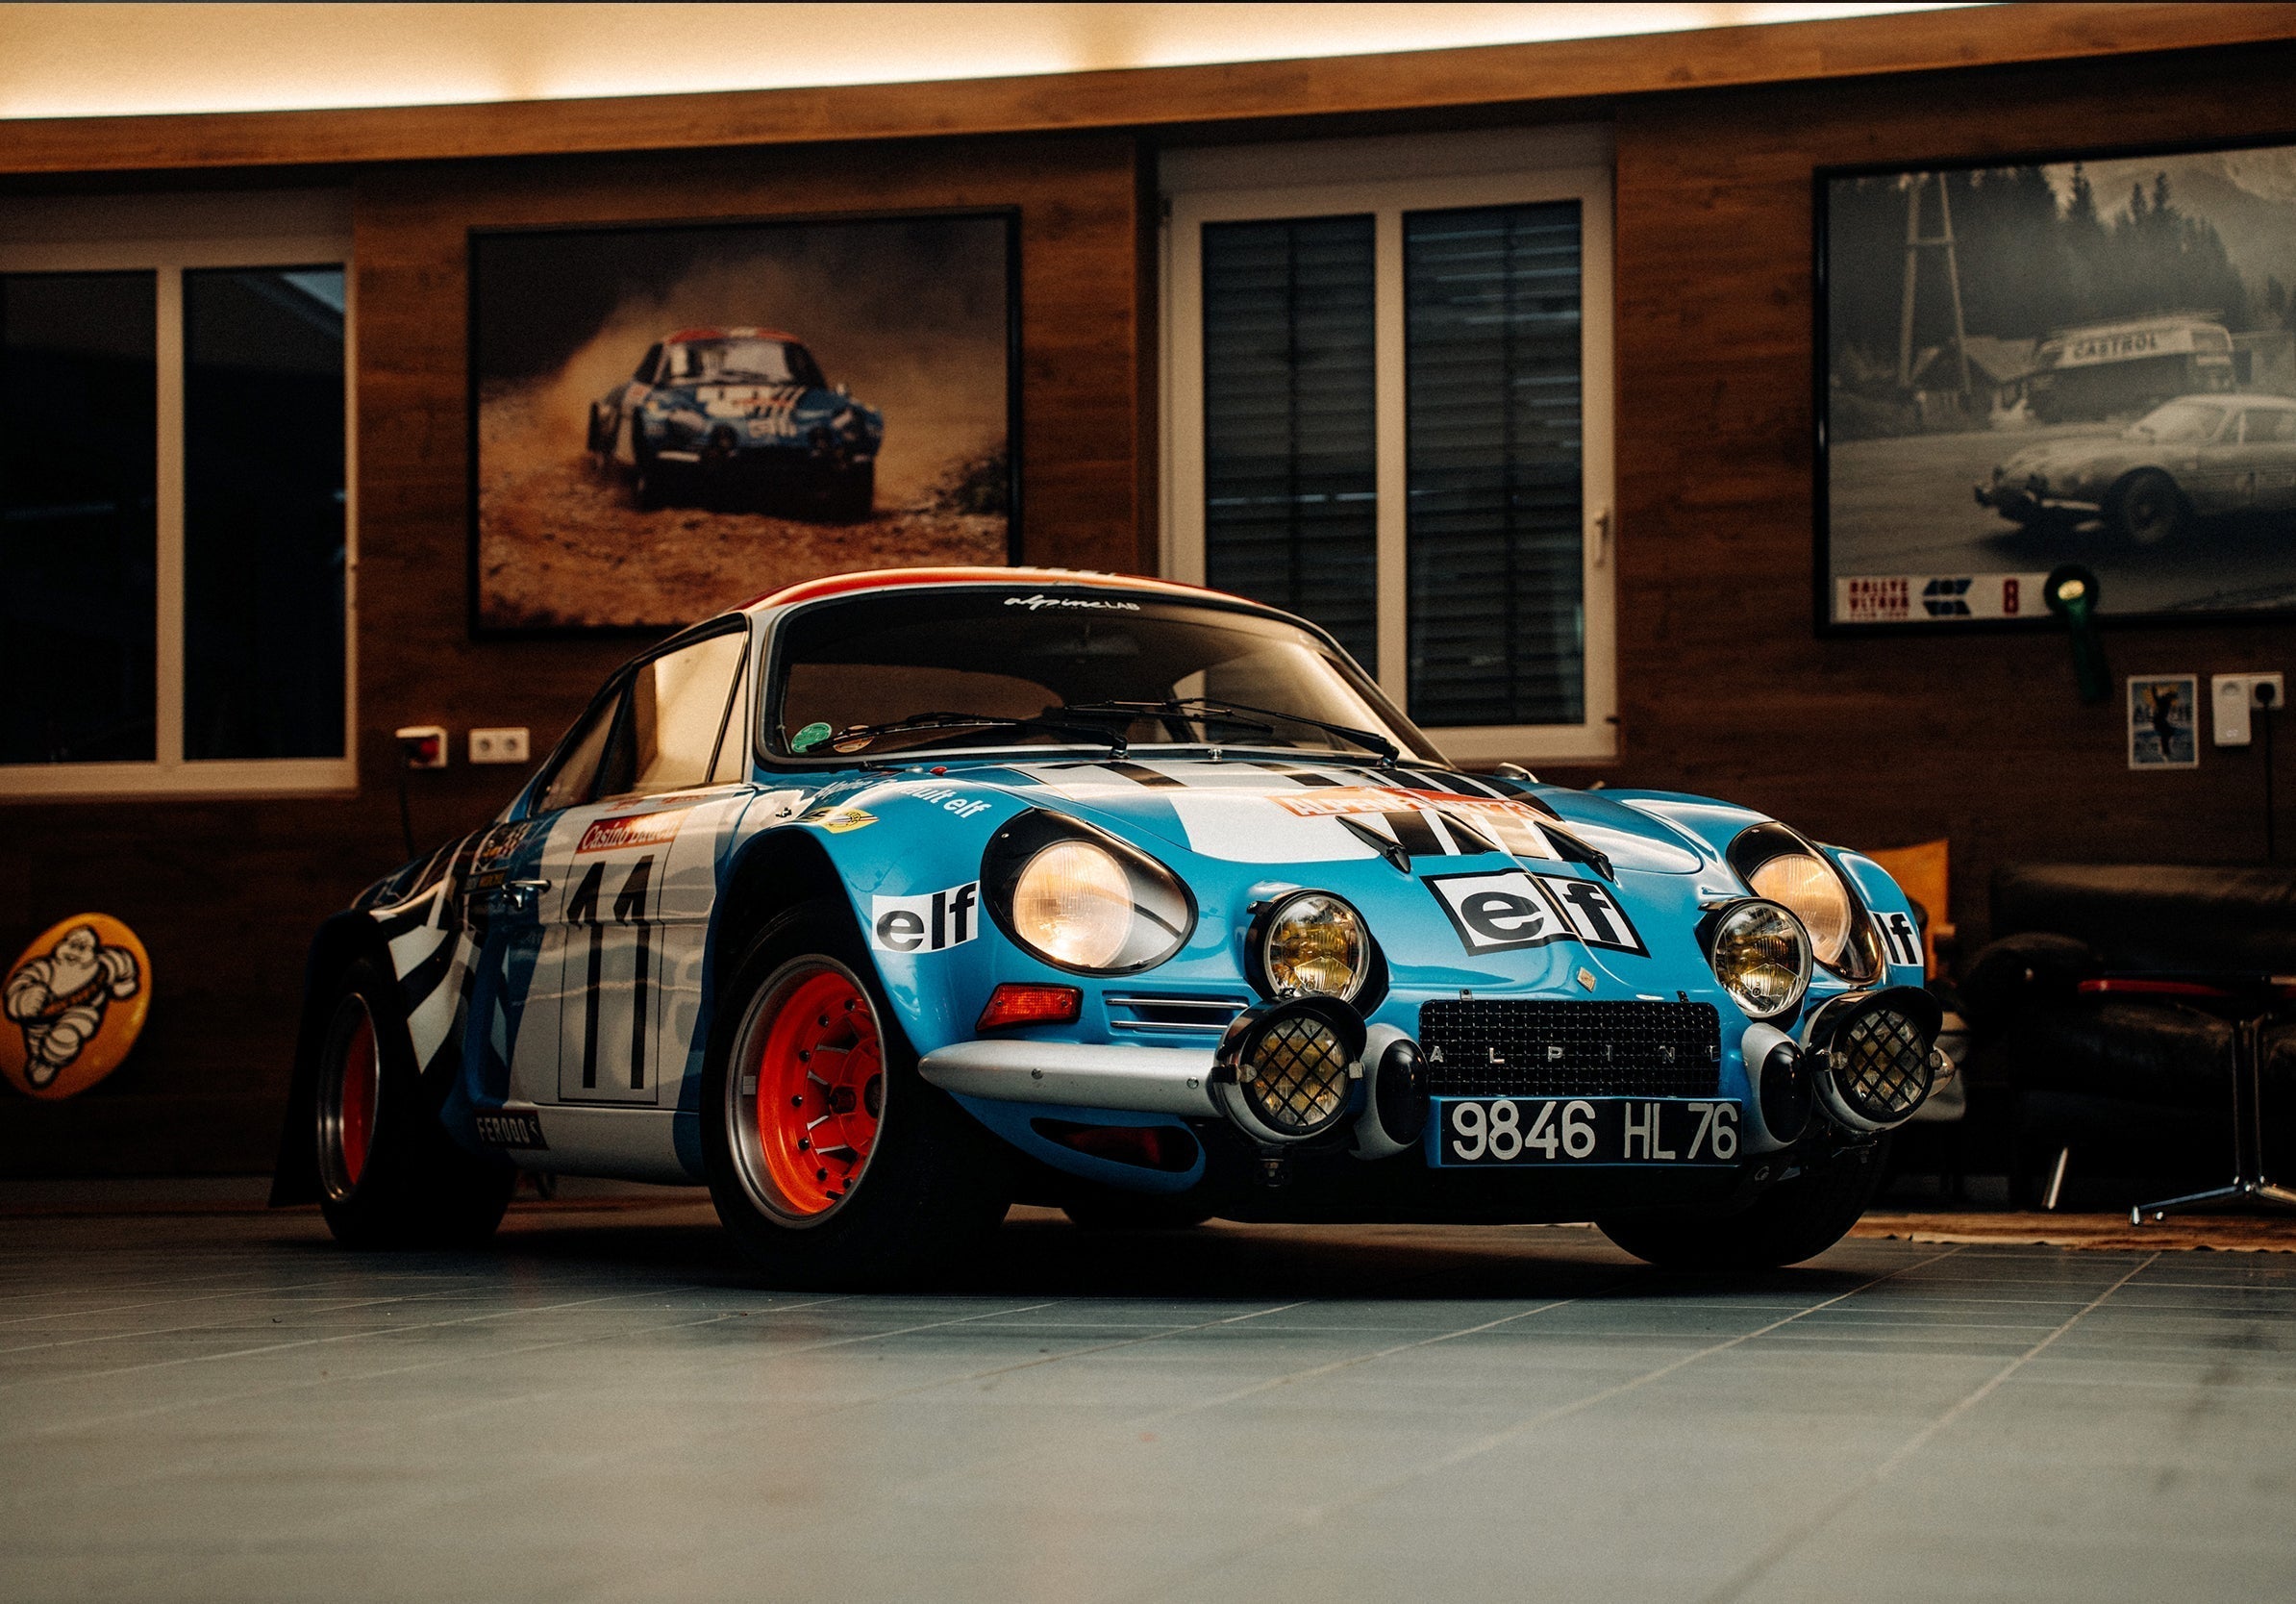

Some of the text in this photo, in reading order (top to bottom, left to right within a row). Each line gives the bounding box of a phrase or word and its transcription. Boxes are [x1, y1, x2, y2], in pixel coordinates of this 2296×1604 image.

[582, 821, 631, 850] Casino
[943, 799, 992, 818] elf
[877, 883, 976, 951] elf
[1460, 873, 1621, 944] elf
[1873, 913, 1917, 965] lf
[566, 855, 655, 1090] 11
[1452, 1100, 1738, 1161] 9846 HL 76
